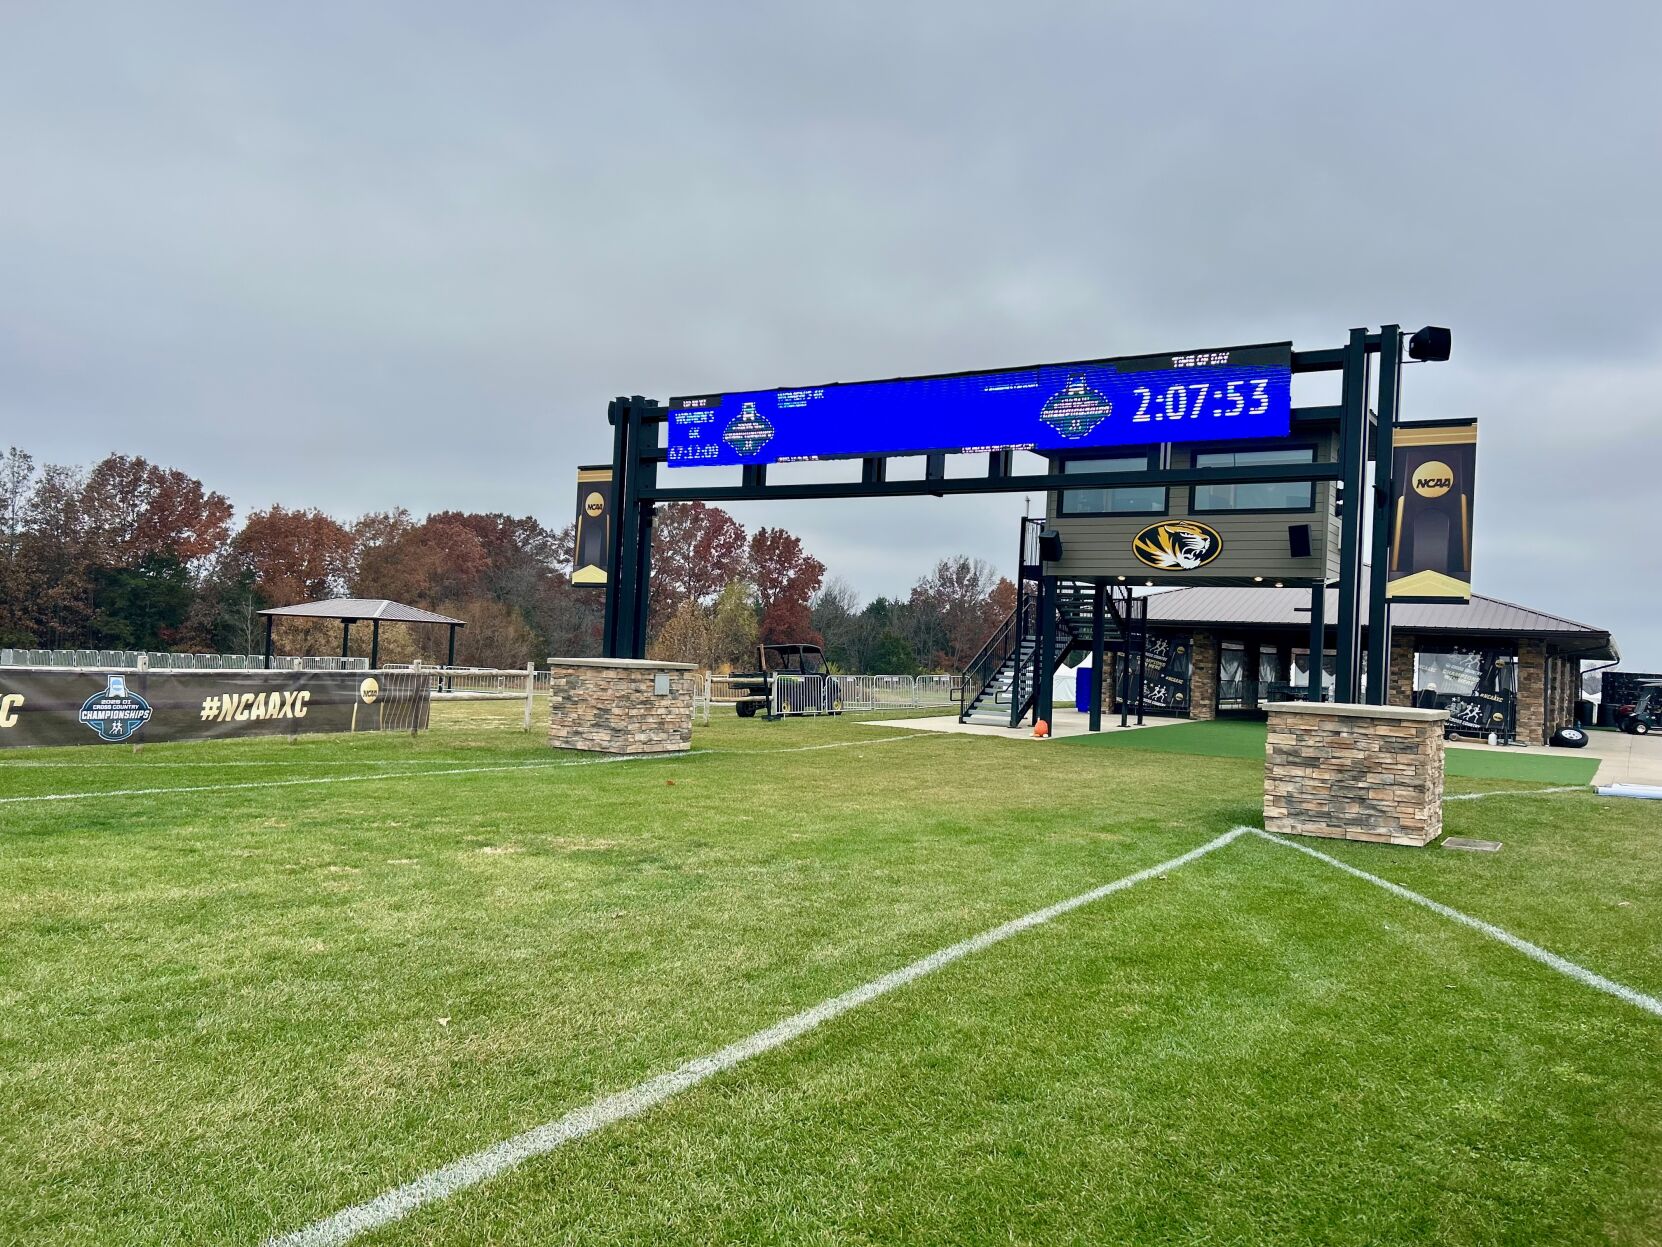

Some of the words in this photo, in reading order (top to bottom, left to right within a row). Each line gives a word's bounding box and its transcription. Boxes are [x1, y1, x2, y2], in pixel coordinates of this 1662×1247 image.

[1171, 355, 1195, 368] TIME
[1196, 354, 1210, 365] OF
[1210, 352, 1230, 365] DAY
[1132, 378, 1269, 423] 2:07:53
[1416, 477, 1451, 489] NCAA
[200, 690, 311, 722] #NCAAXC
[82, 709, 150, 720] CHAMPIONSHIPS
